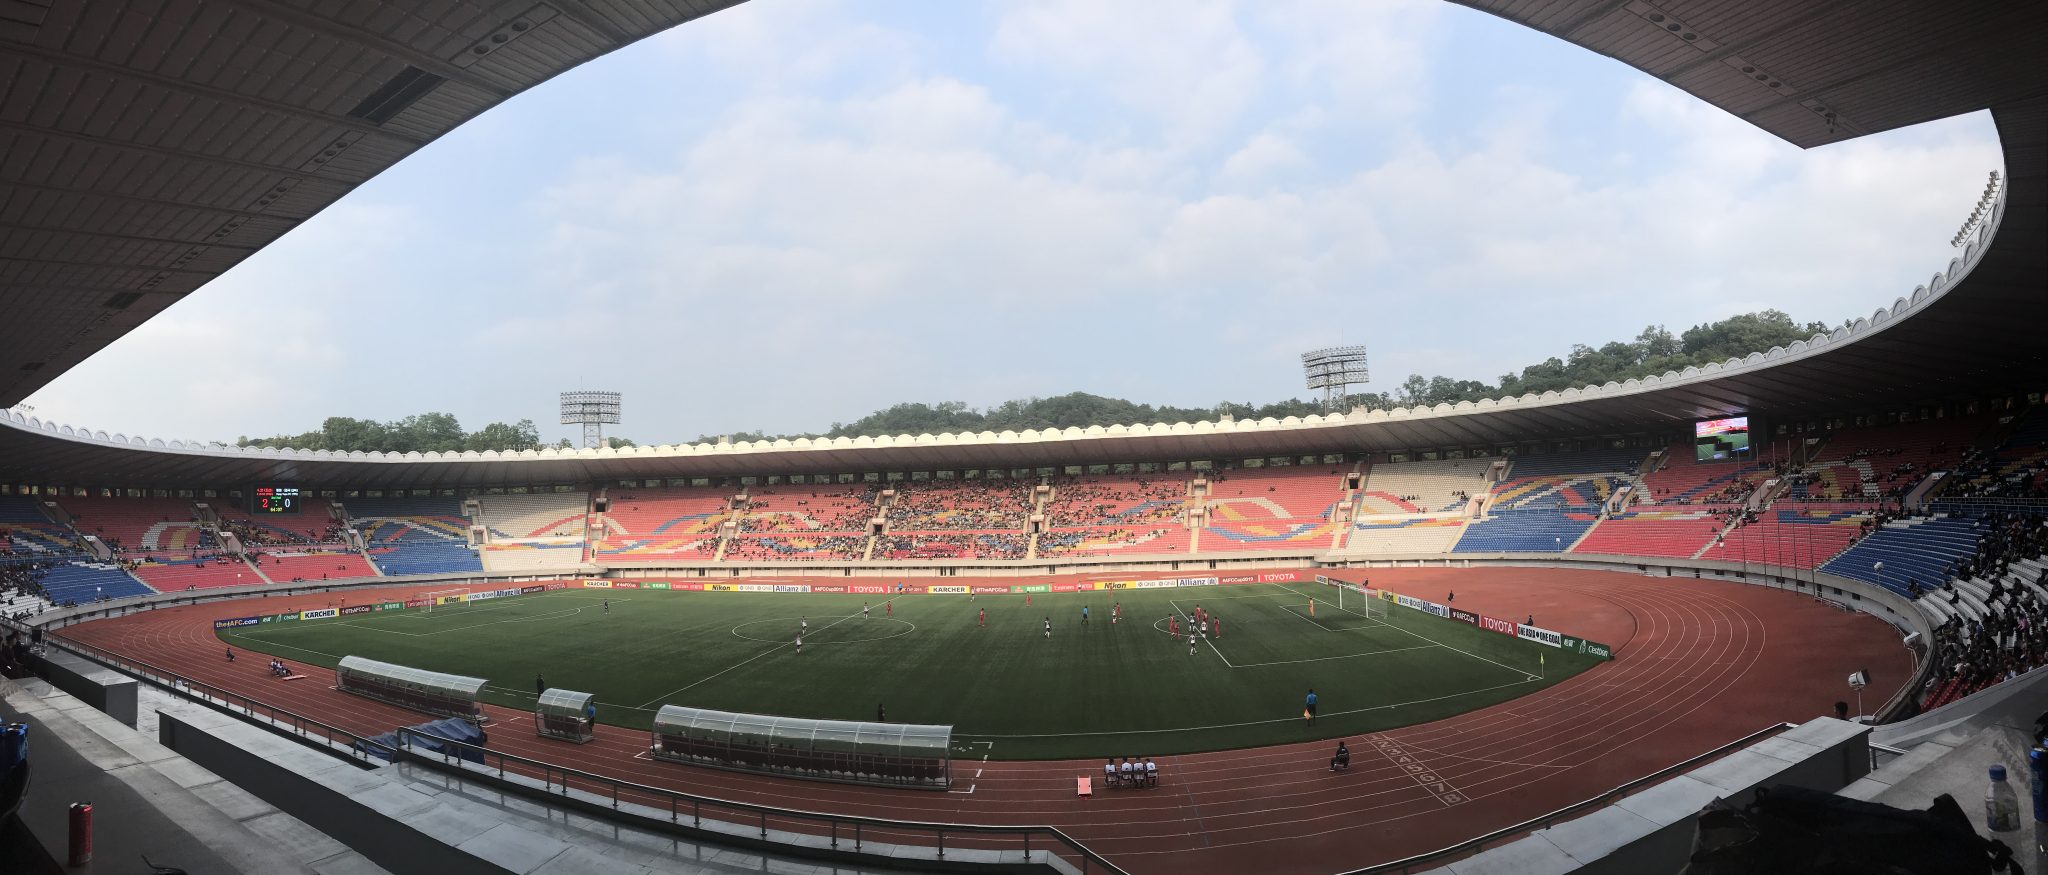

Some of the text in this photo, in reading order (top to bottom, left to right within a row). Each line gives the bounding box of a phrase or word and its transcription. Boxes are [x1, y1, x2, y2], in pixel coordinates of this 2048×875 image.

[262, 499, 268, 508] 2
[285, 498, 290, 508] 0
[1263, 573, 1296, 581] TOYOTA
[1423, 601, 1441, 615] Allianz
[1484, 617, 1514, 635] TOYOTA
[1518, 626, 1526, 637] ONE
[1526, 628, 1536, 638] ASIA
[1539, 631, 1549, 642] ONE
[1549, 633, 1560, 645] GOAL
[1444, 794, 1461, 803] 8
